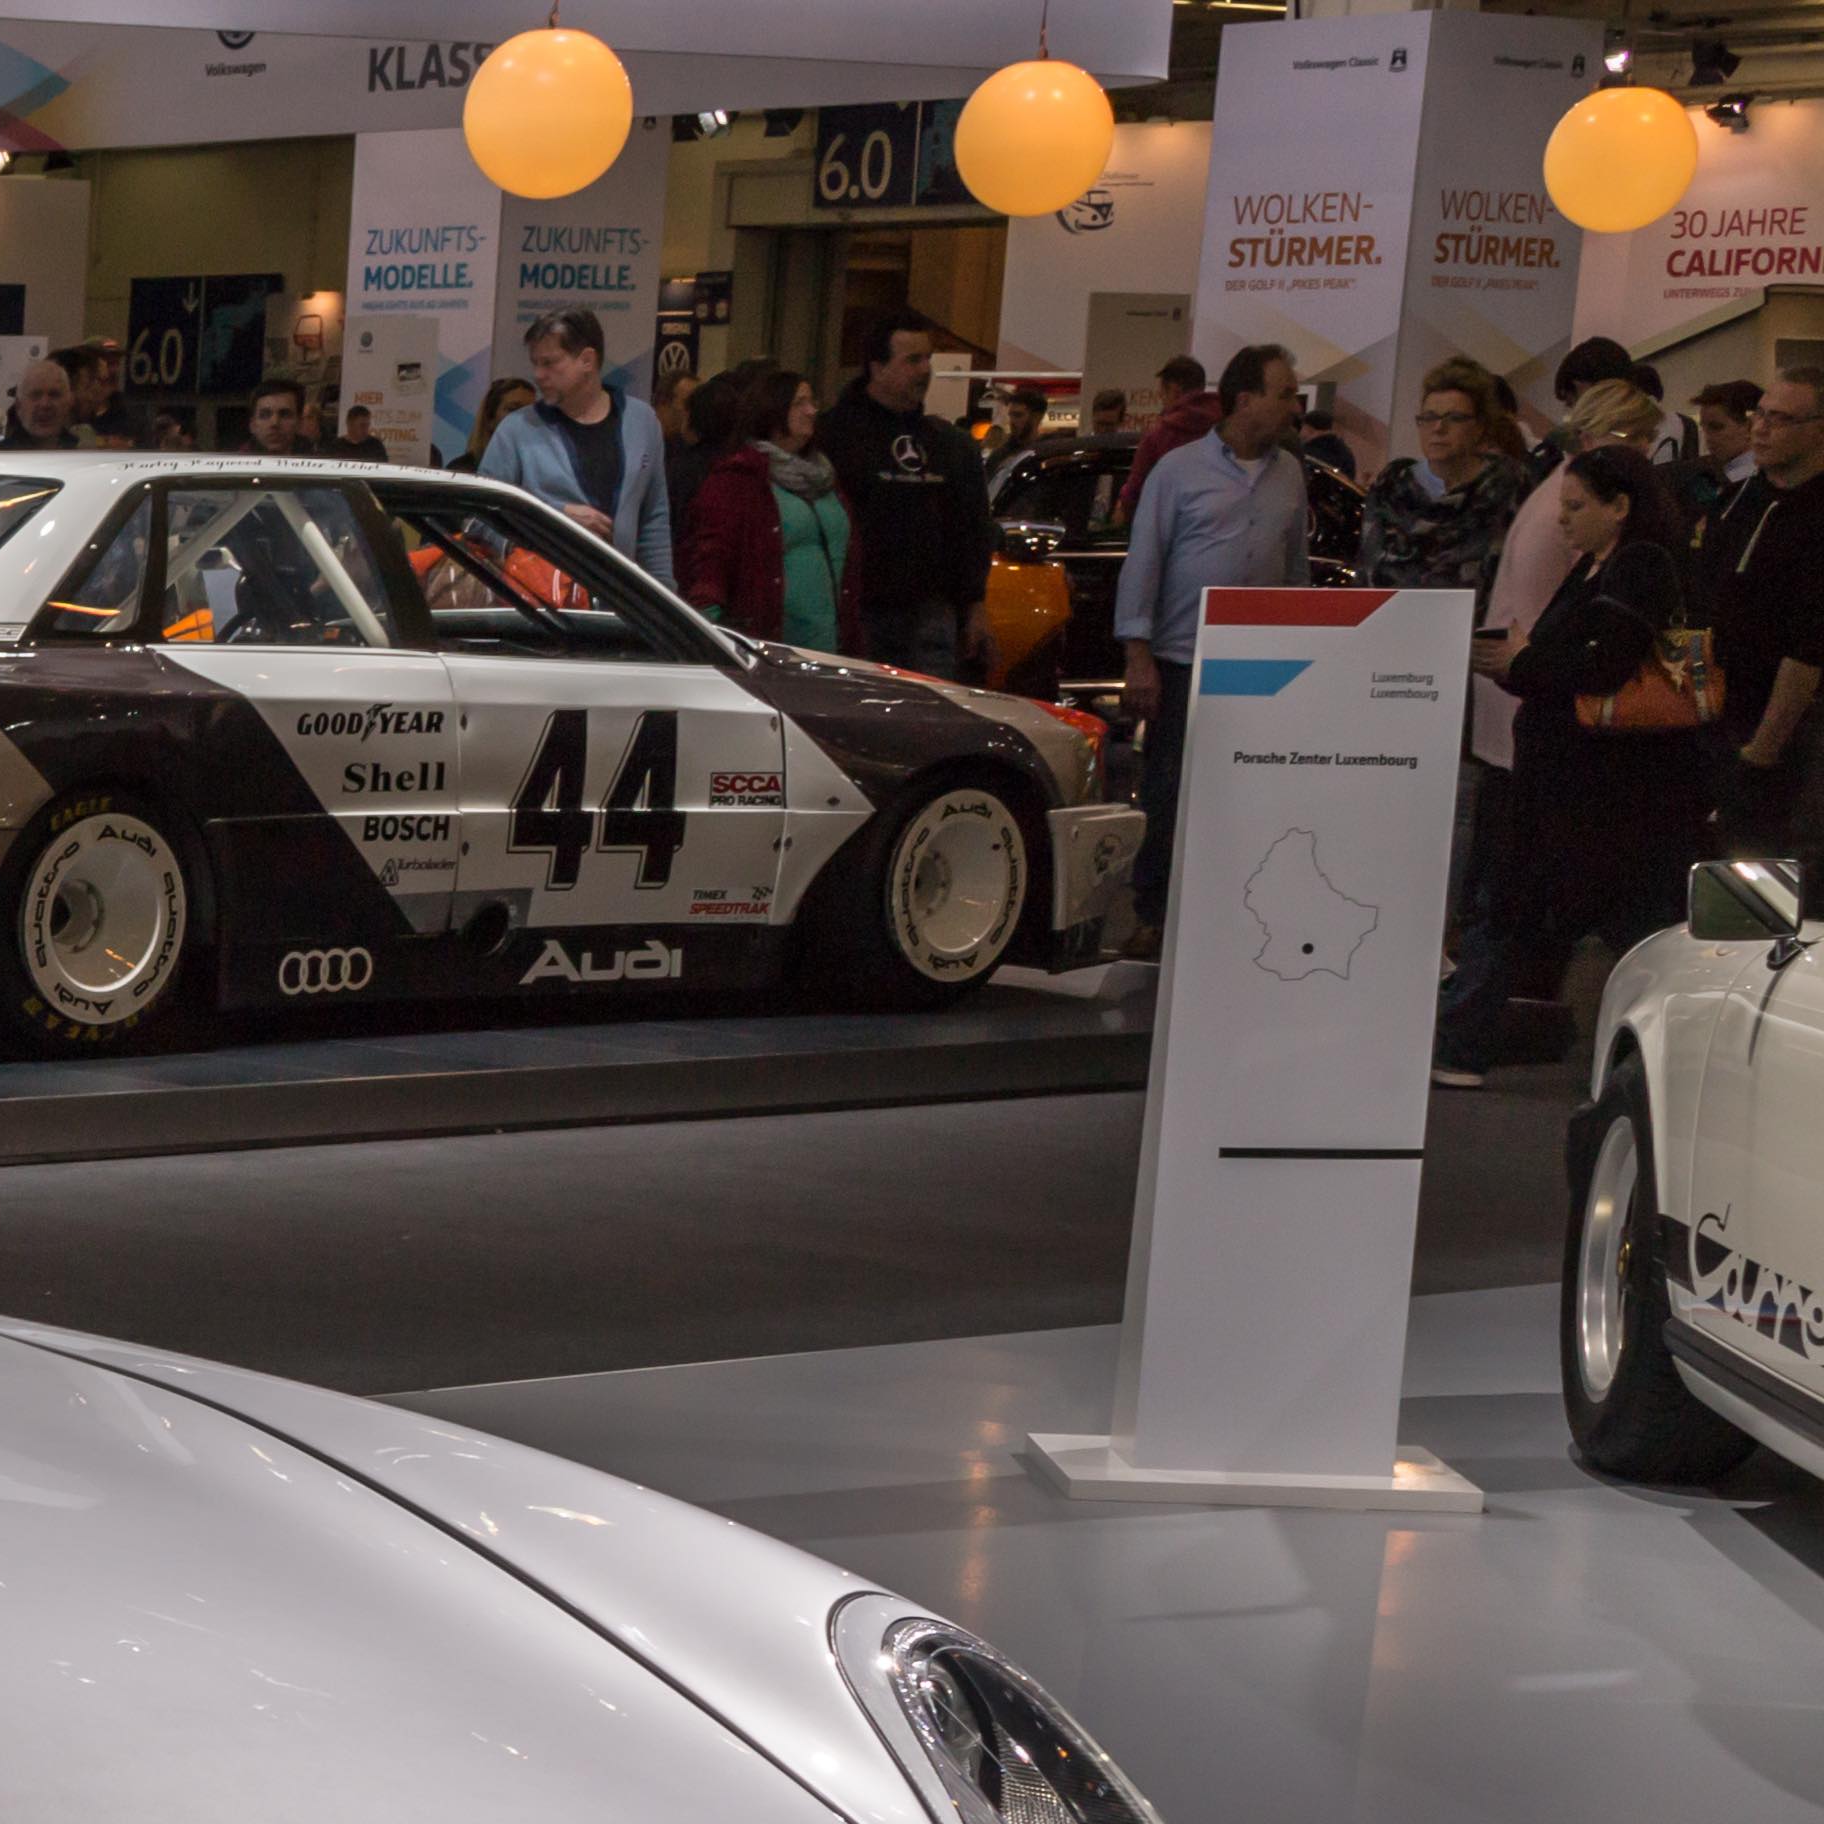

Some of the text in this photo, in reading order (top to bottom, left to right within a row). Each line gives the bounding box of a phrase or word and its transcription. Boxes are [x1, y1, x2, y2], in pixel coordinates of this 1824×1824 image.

[205, 62, 267, 77] Volkswagen
[819, 130, 892, 201] 6.0
[1233, 192, 1374, 225] WOLKEN-
[1441, 189, 1554, 225] WOLKEN-
[1670, 207, 1808, 239] 30 JAHRE
[366, 225, 487, 256] ZUKUNFTS-
[521, 226, 650, 255] ZUKUNFTS-
[1228, 229, 1382, 268] STÜRMER.
[1434, 226, 1560, 268] STÜRMER.
[364, 263, 474, 291] MODELLE.
[519, 263, 637, 291] MODELLE.
[1666, 246, 1824, 278] CALIFORN
[1248, 280, 1276, 291] GOLF
[130, 328, 183, 385] 6.0
[1372, 671, 1433, 685] Luxemburg
[1370, 687, 1439, 701] Luxembourg
[1233, 751, 1418, 769] Porsche Zenter Luxembourg
[342, 762, 445, 793] Shell
[713, 775, 781, 793] SCCA
[507, 709, 687, 890] 44
[712, 795, 783, 806] PRO RACING
[940, 803, 993, 821] Audi
[97, 824, 157, 858] Audi
[363, 815, 450, 841] BOSCH
[32, 841, 80, 969] quattro
[688, 902, 769, 915] SPEEDTRAK
[693, 889, 728, 900] TIMEX
[133, 871, 178, 998] quattro
[519, 939, 683, 985] Audi
